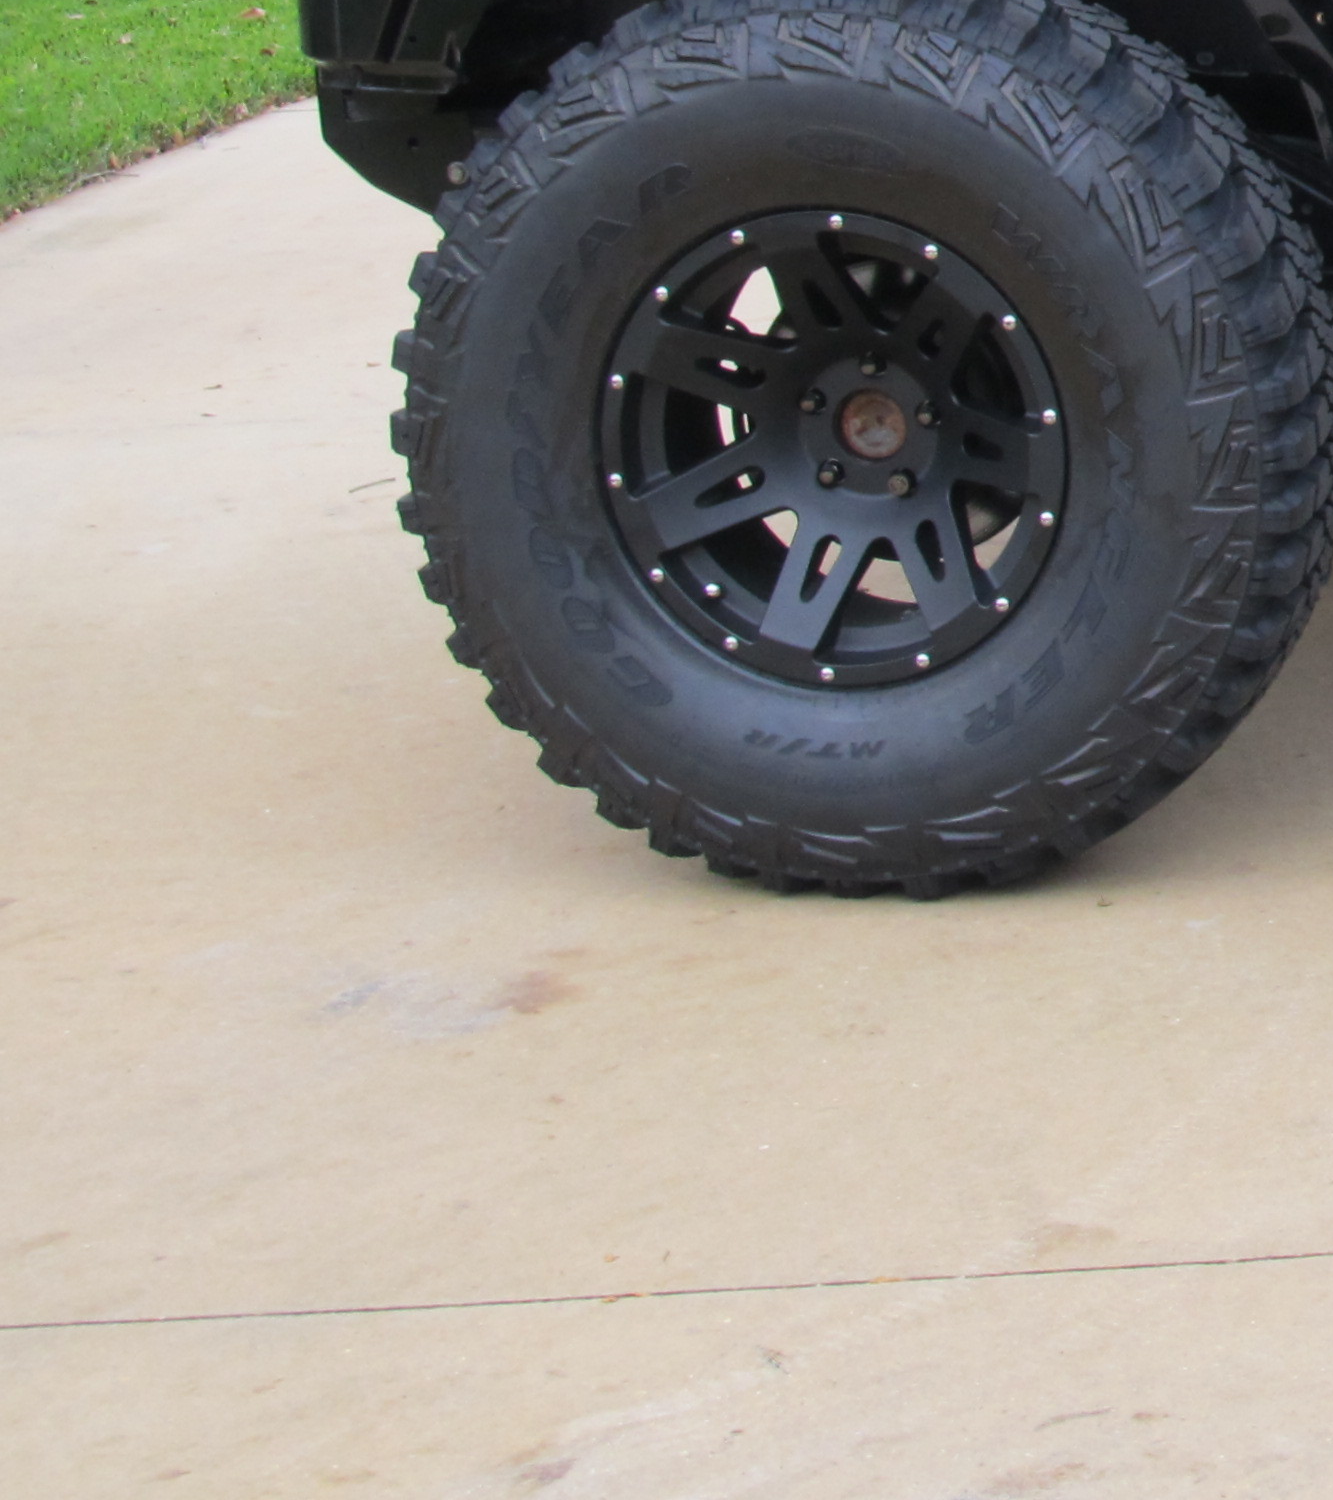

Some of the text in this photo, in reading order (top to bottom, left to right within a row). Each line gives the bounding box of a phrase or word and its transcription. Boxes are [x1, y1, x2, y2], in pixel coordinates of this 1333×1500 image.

[512, 161, 694, 710] GOODYEAR
[960, 203, 1135, 745] WRANGLER
[740, 727, 885, 758] MT/R
